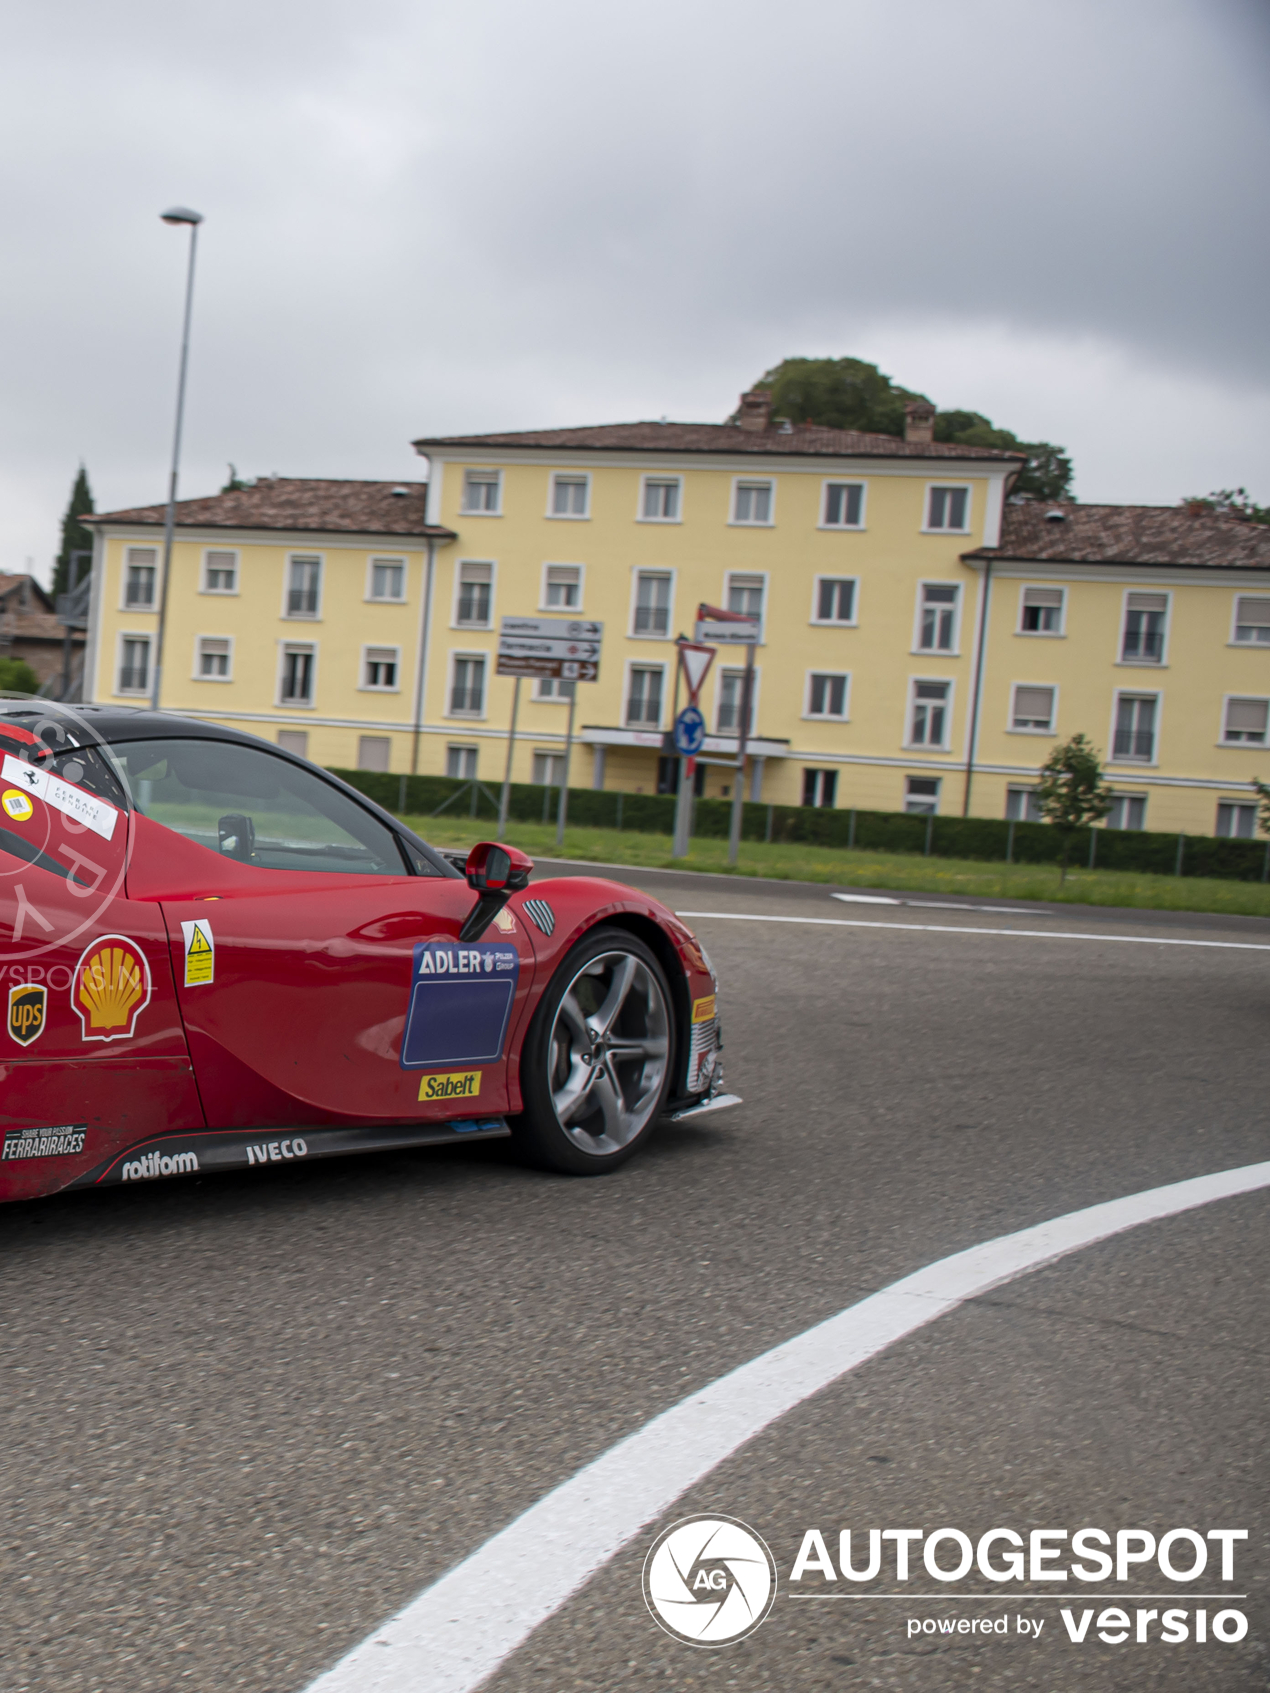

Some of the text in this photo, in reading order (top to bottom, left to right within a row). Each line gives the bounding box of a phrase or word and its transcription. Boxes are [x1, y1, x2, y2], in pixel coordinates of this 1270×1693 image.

[54, 792, 97, 821] GENUINE
[56, 787, 100, 815] FERRARI
[418, 950, 481, 974] ADLER
[495, 961, 514, 971] GROUP
[12, 1004, 42, 1035] ups
[425, 1074, 475, 1098] Sabelt
[21, 1126, 74, 1138] SHARE YOUR PASSION
[1, 1133, 85, 1159] FERRARIRACES
[246, 1138, 308, 1165] IVECO
[121, 1151, 199, 1181] rotiform
